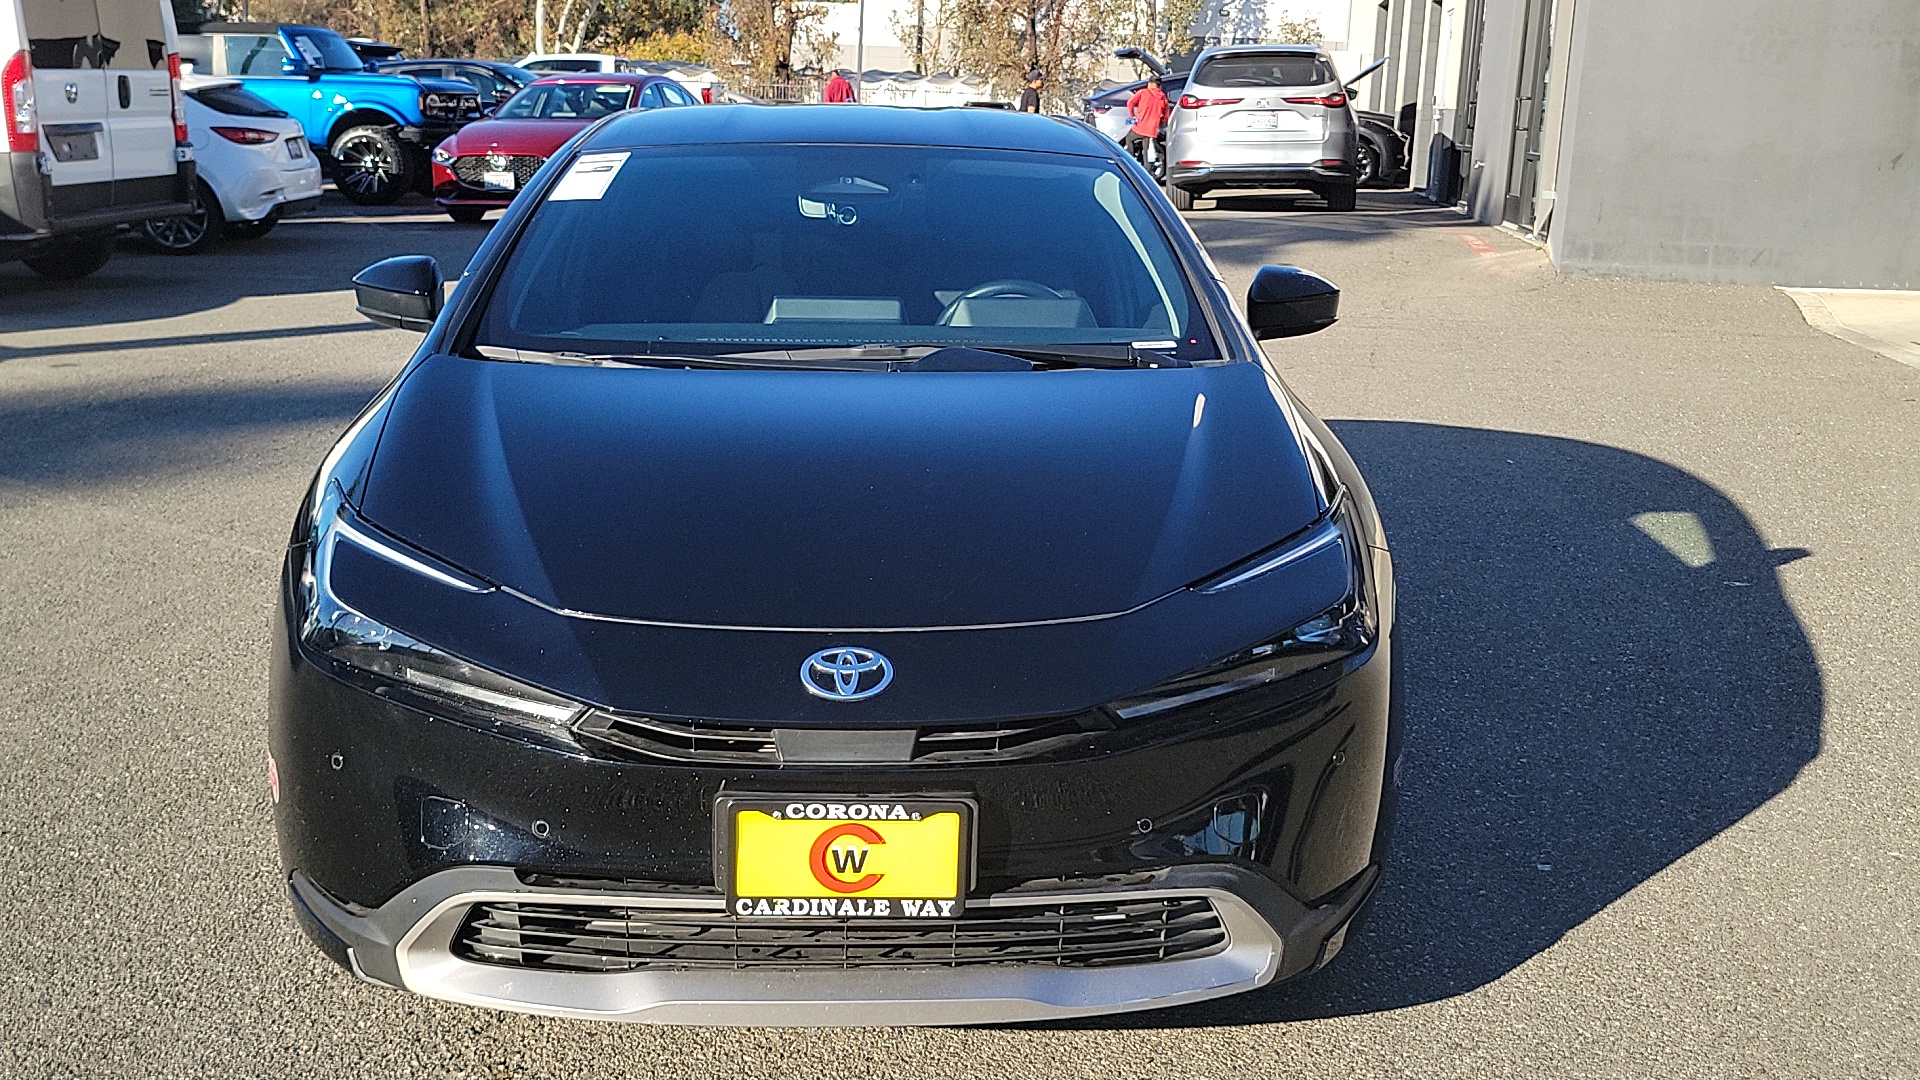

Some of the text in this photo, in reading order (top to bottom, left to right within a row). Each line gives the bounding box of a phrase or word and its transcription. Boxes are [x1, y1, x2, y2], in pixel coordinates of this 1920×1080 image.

[785, 803, 910, 820] CORONA
[735, 898, 956, 917] CARDINALE WAY
